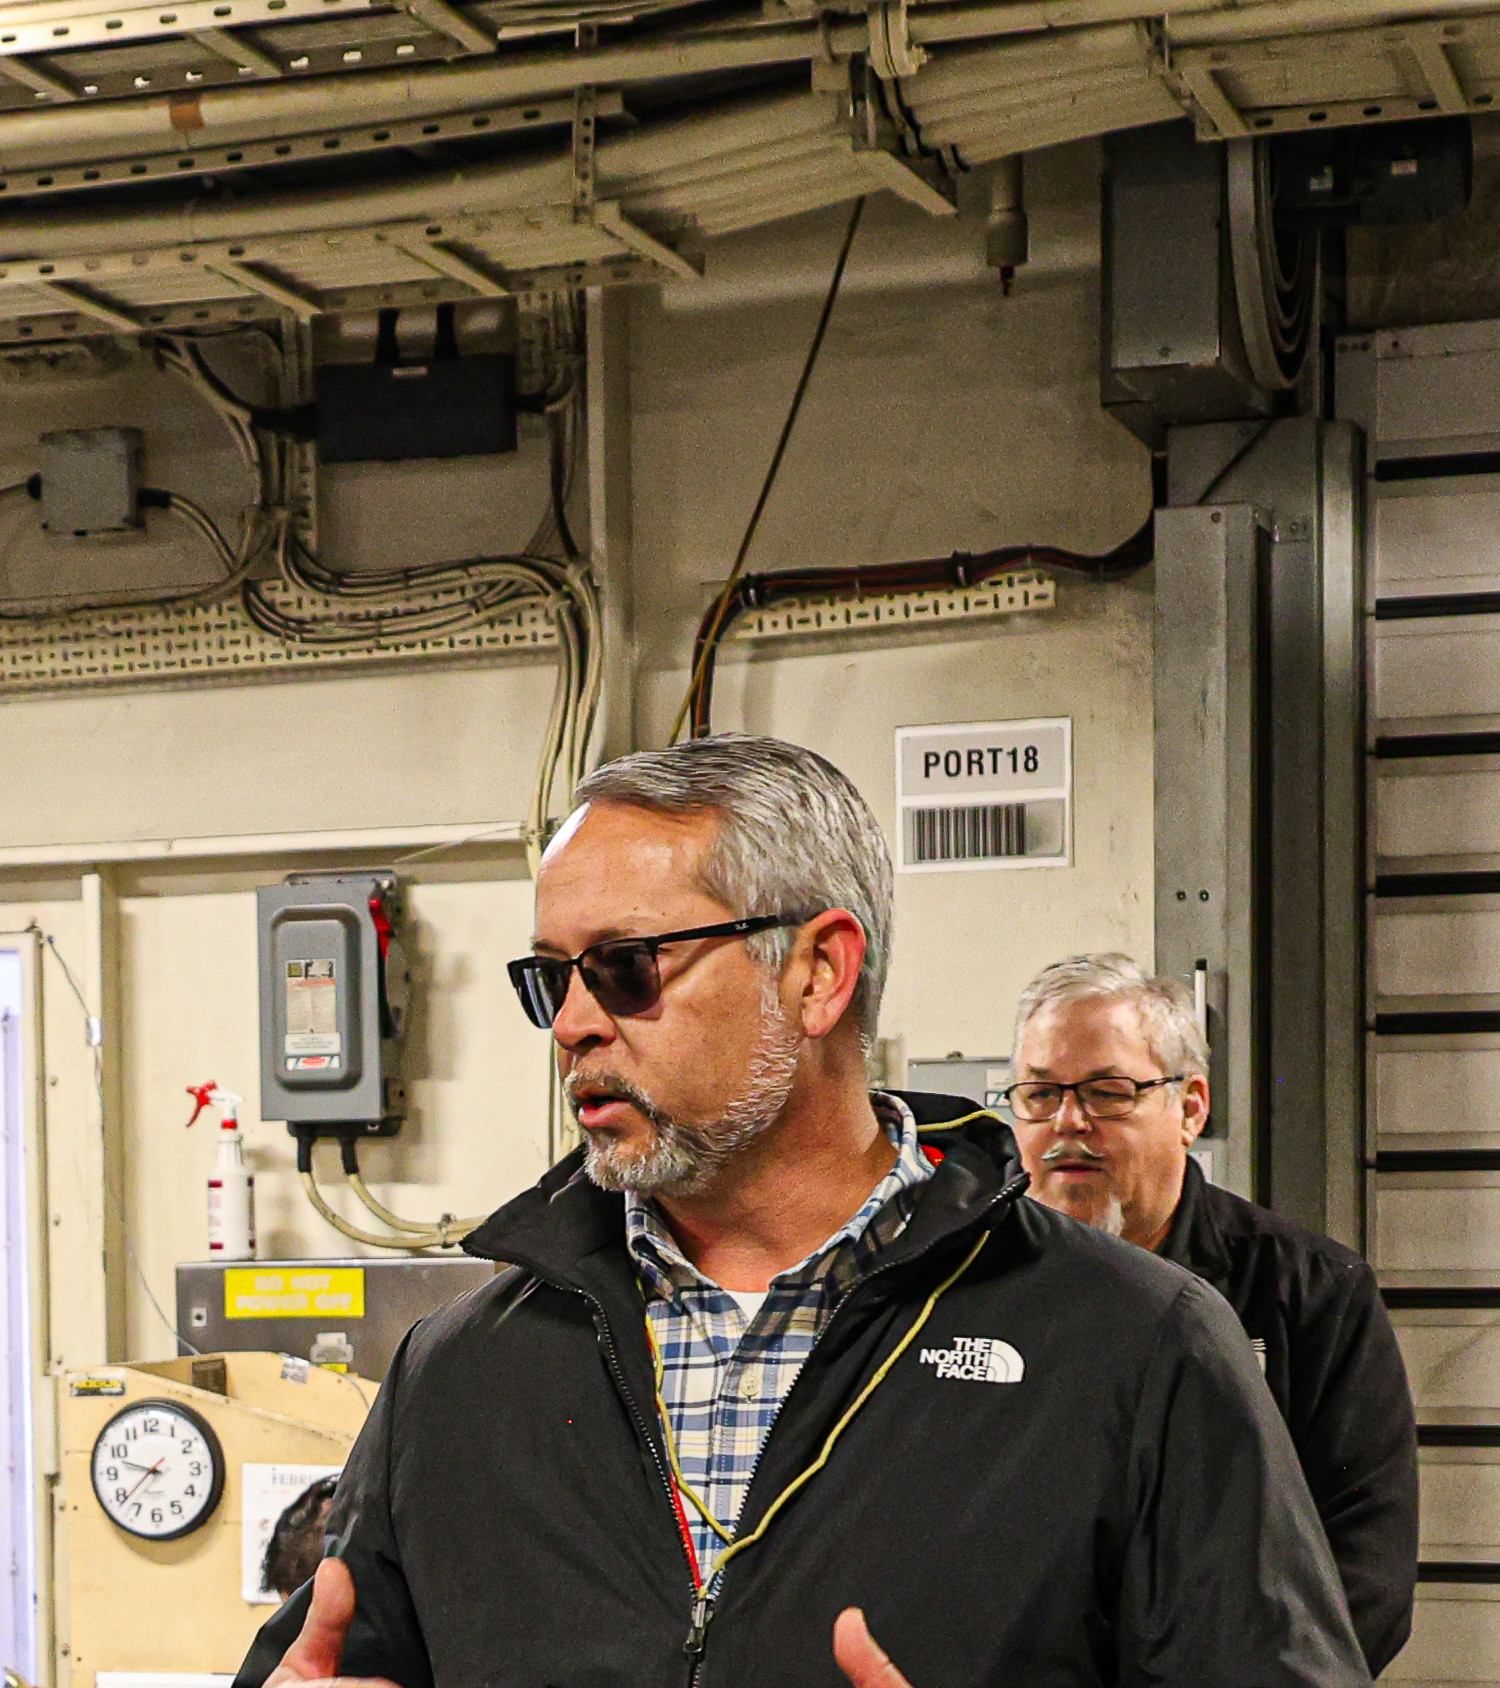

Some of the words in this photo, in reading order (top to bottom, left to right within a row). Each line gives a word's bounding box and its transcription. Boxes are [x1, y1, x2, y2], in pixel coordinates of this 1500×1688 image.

[924, 745, 1038, 778] PORT18
[953, 1337, 991, 1352] THE
[919, 1349, 989, 1366] NORTH
[936, 1364, 987, 1381] FACE
[143, 1418, 159, 1433] 12
[170, 1424, 175, 1438] 1
[125, 1427, 137, 1440] 11
[111, 1443, 128, 1459] 10
[181, 1440, 192, 1454] 2
[106, 1466, 118, 1481] 9
[189, 1461, 201, 1476] 3
[115, 1487, 127, 1503] 8
[184, 1484, 195, 1498] 4
[131, 1502, 142, 1517] 7
[170, 1500, 182, 1515] 5
[151, 1508, 163, 1523] 6
